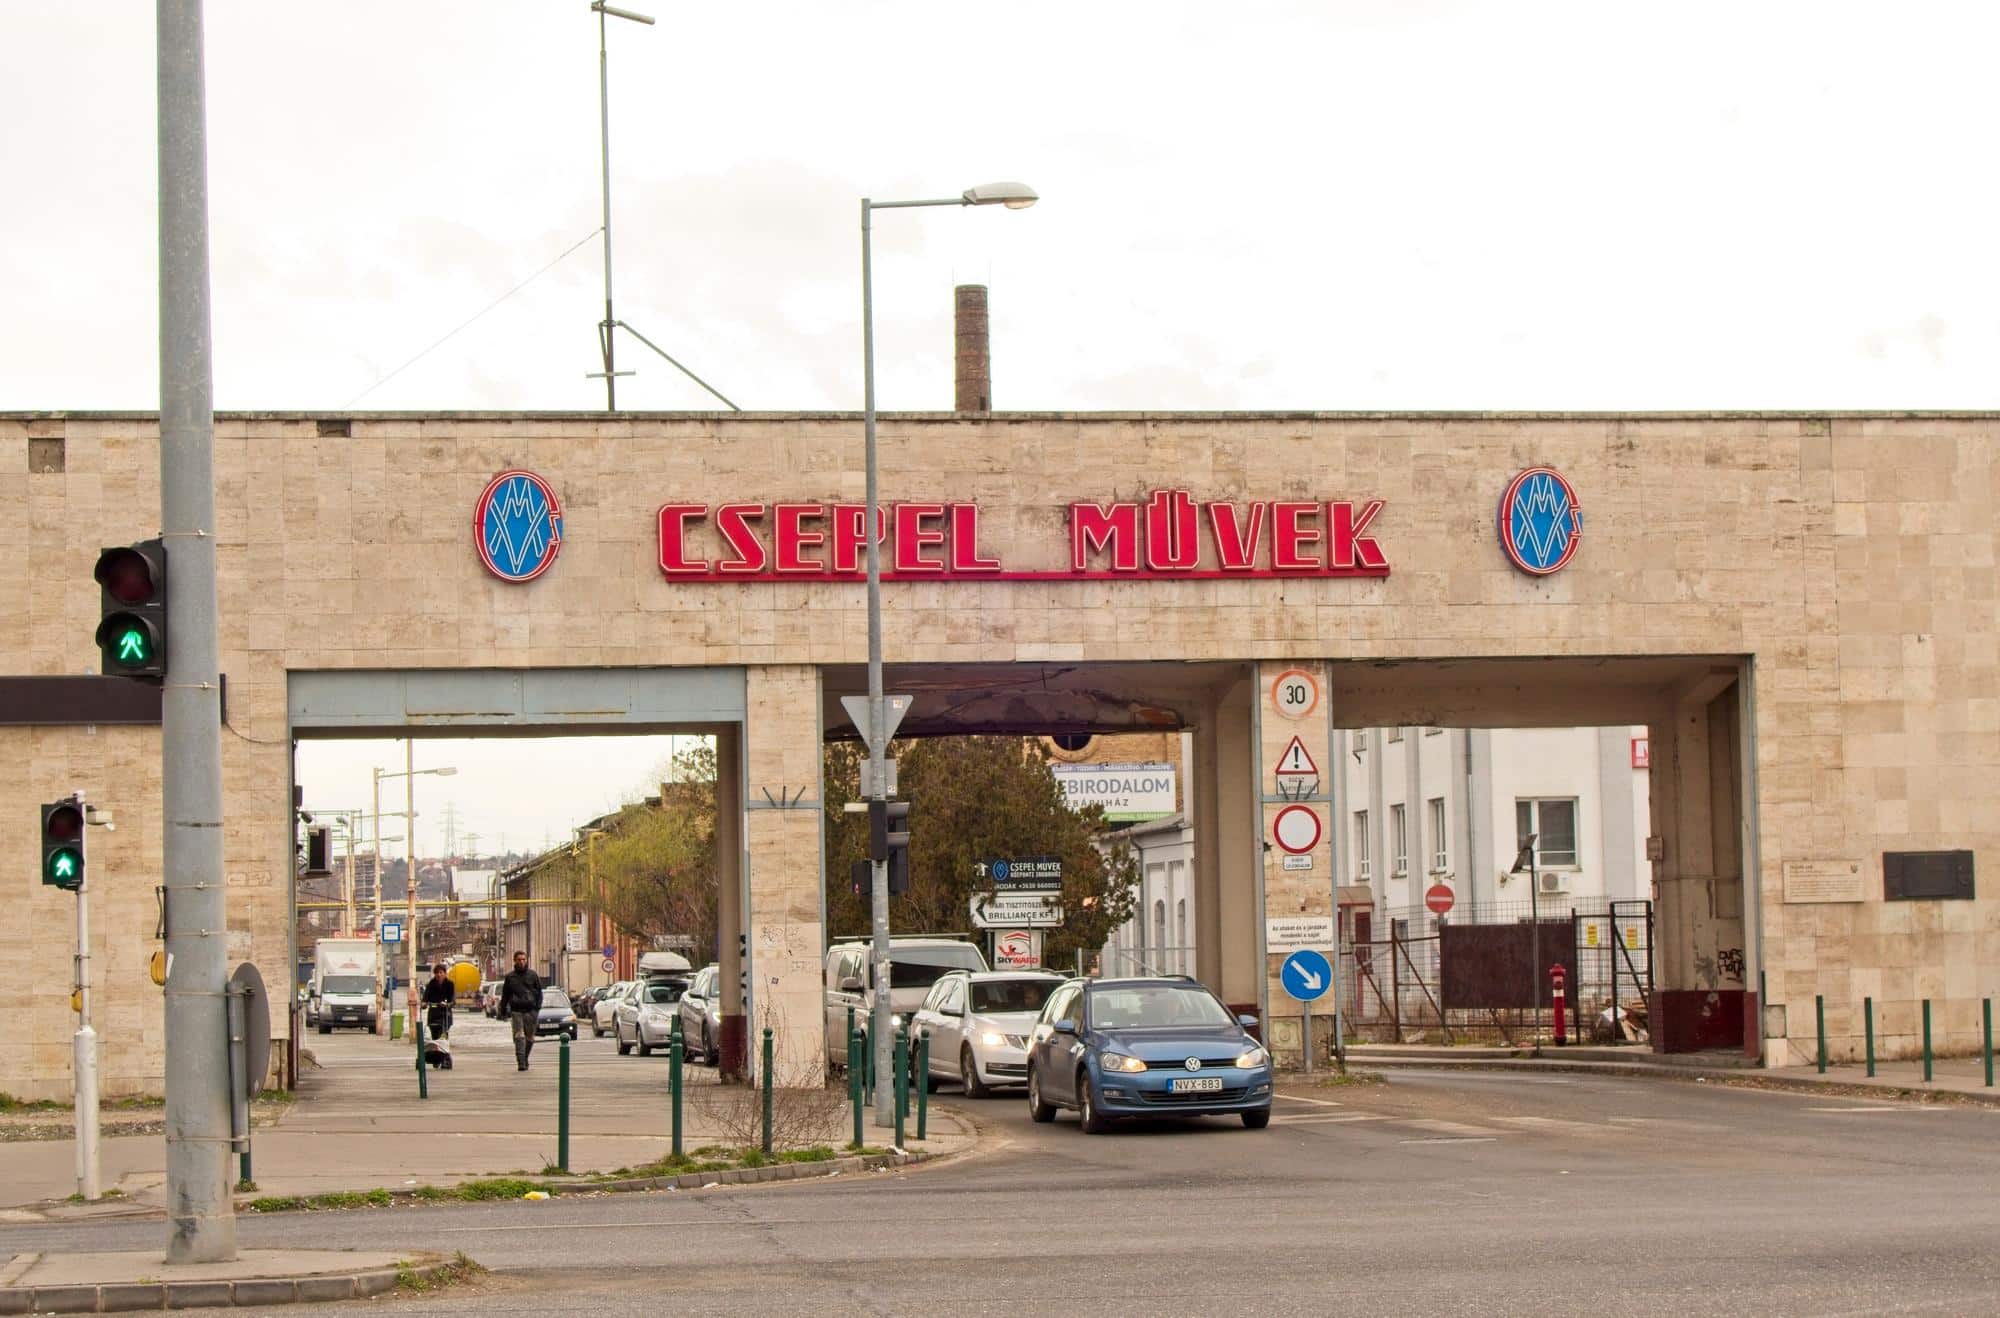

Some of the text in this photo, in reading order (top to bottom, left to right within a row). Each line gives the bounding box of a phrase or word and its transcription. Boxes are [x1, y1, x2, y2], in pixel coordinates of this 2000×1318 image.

[658, 503, 1001, 573] CSEPEL
[1286, 685, 1305, 704] 30
[1010, 862, 1035, 872] CSEPEL
[988, 911, 1036, 920] BRILLIANCE
[1175, 1079, 1220, 1089] NVX-883
